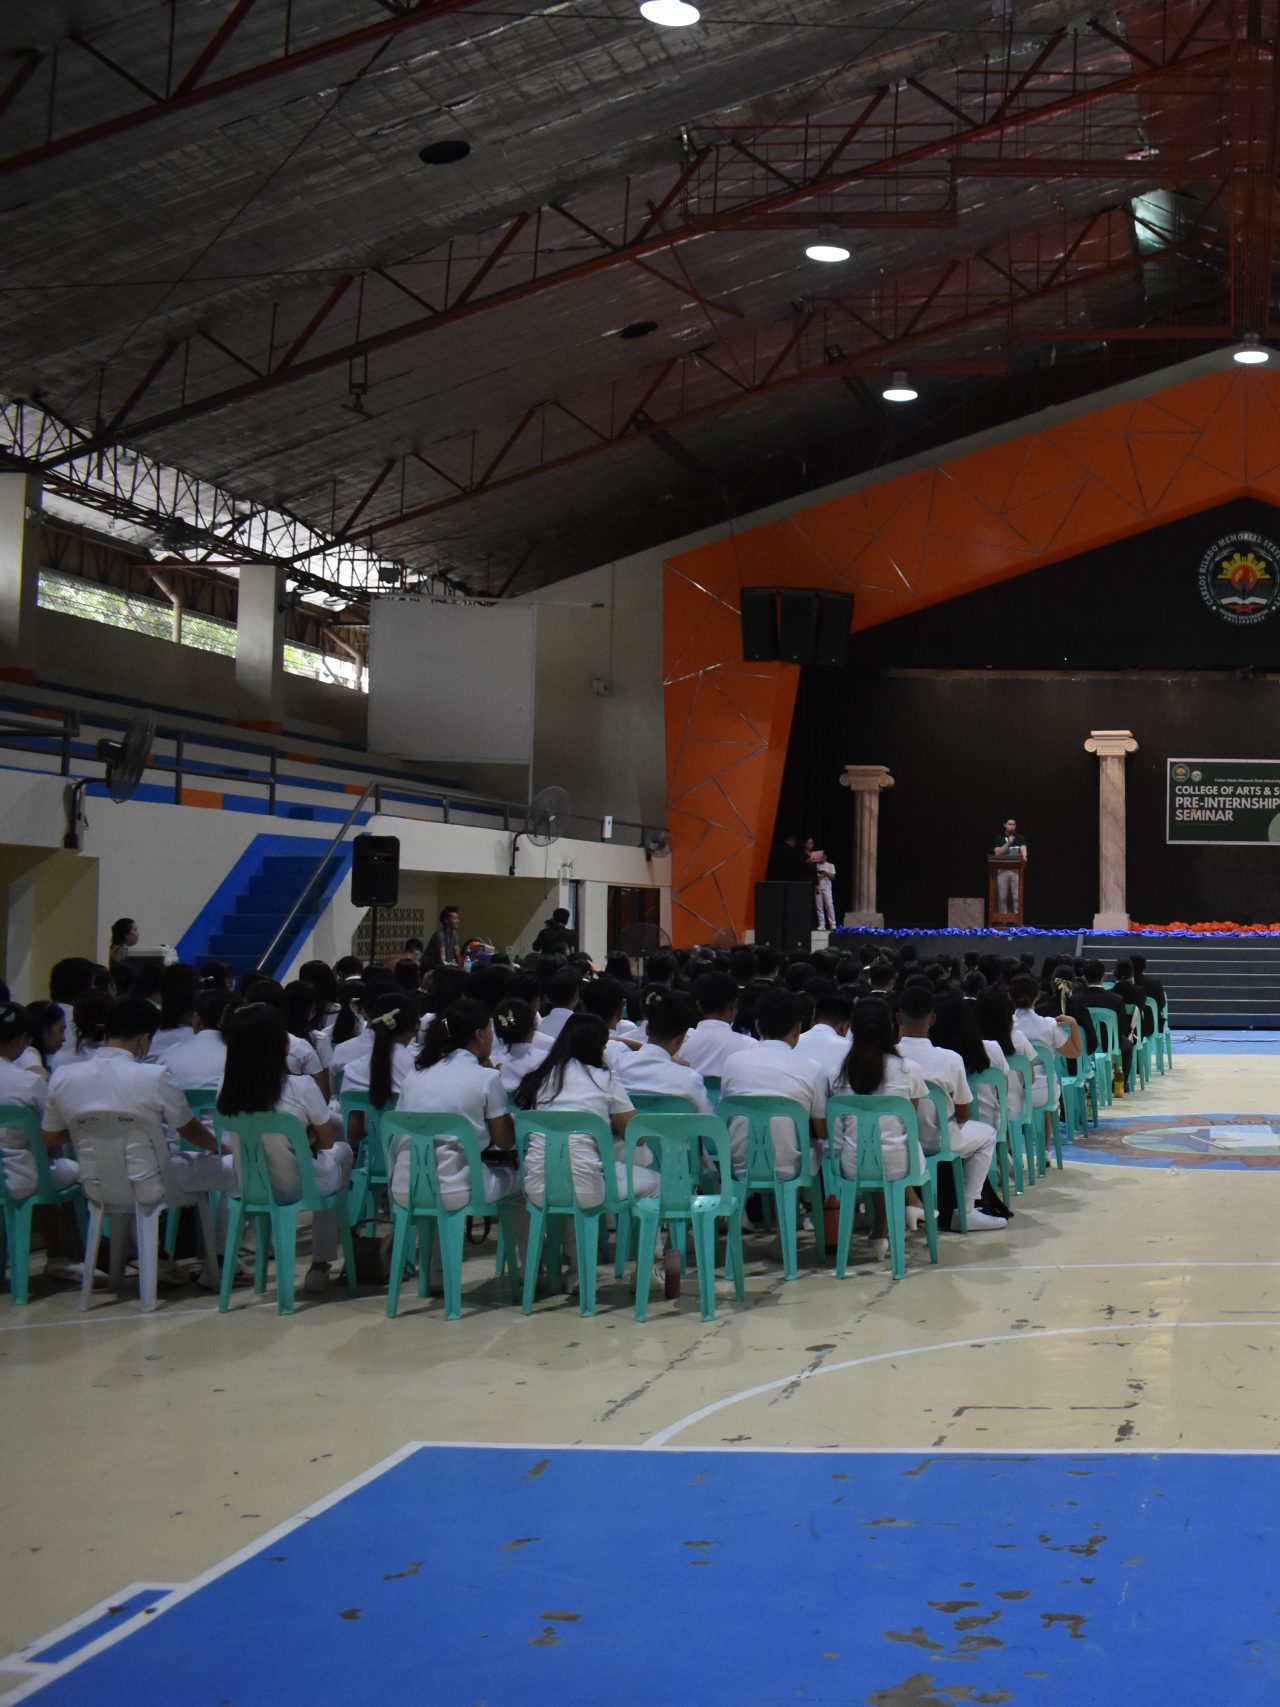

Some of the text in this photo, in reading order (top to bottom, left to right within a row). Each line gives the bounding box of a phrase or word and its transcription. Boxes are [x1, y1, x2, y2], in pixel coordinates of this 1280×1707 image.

[1218, 533, 1262, 545] MEMORIAL
[1200, 545, 1218, 573] HILADO
[1199, 575, 1213, 605] CARLOS
[1175, 785, 1219, 795] COLLEGE
[1220, 786, 1235, 795] OF
[1236, 786, 1262, 795] ARTS
[1263, 786, 1272, 795] &
[1175, 797, 1280, 809] PRE-INTERNSHIP
[1175, 809, 1234, 821] SEMINAR
